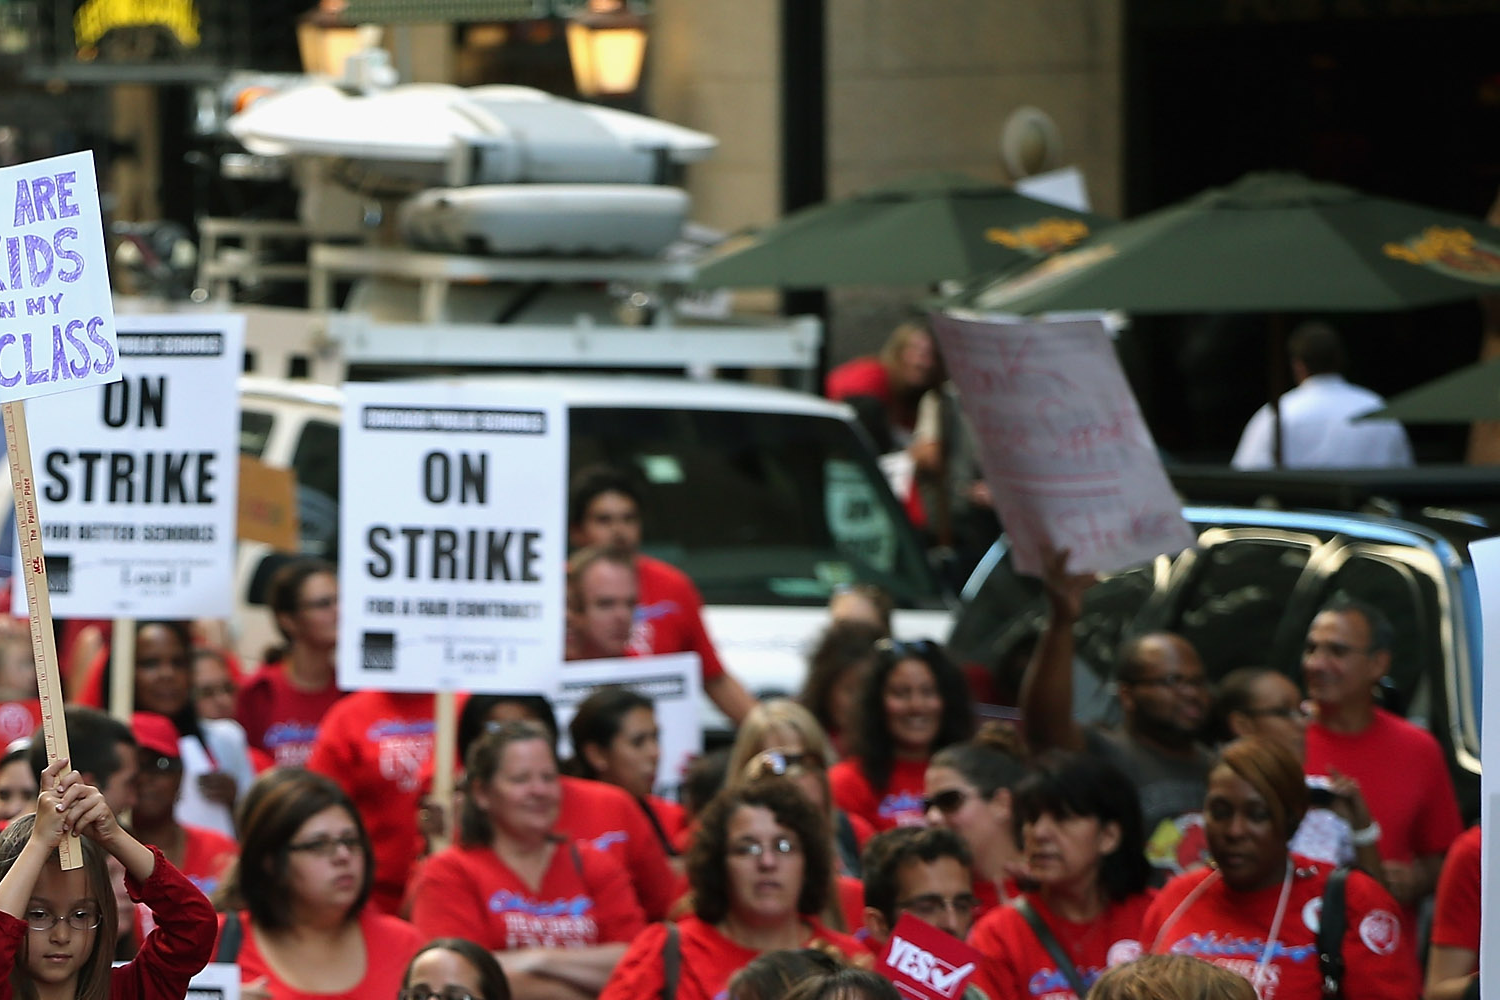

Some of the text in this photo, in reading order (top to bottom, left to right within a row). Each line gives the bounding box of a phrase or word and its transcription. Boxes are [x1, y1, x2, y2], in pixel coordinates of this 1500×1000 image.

[13, 171, 80, 226] ARE
[25, 293, 64, 316] MY
[102, 375, 165, 428] ON
[24, 478, 32, 496] Place
[45, 453, 215, 503] STRIKE
[424, 452, 487, 503] ON
[366, 527, 541, 582] STRIKE
[886, 935, 937, 983] YES
